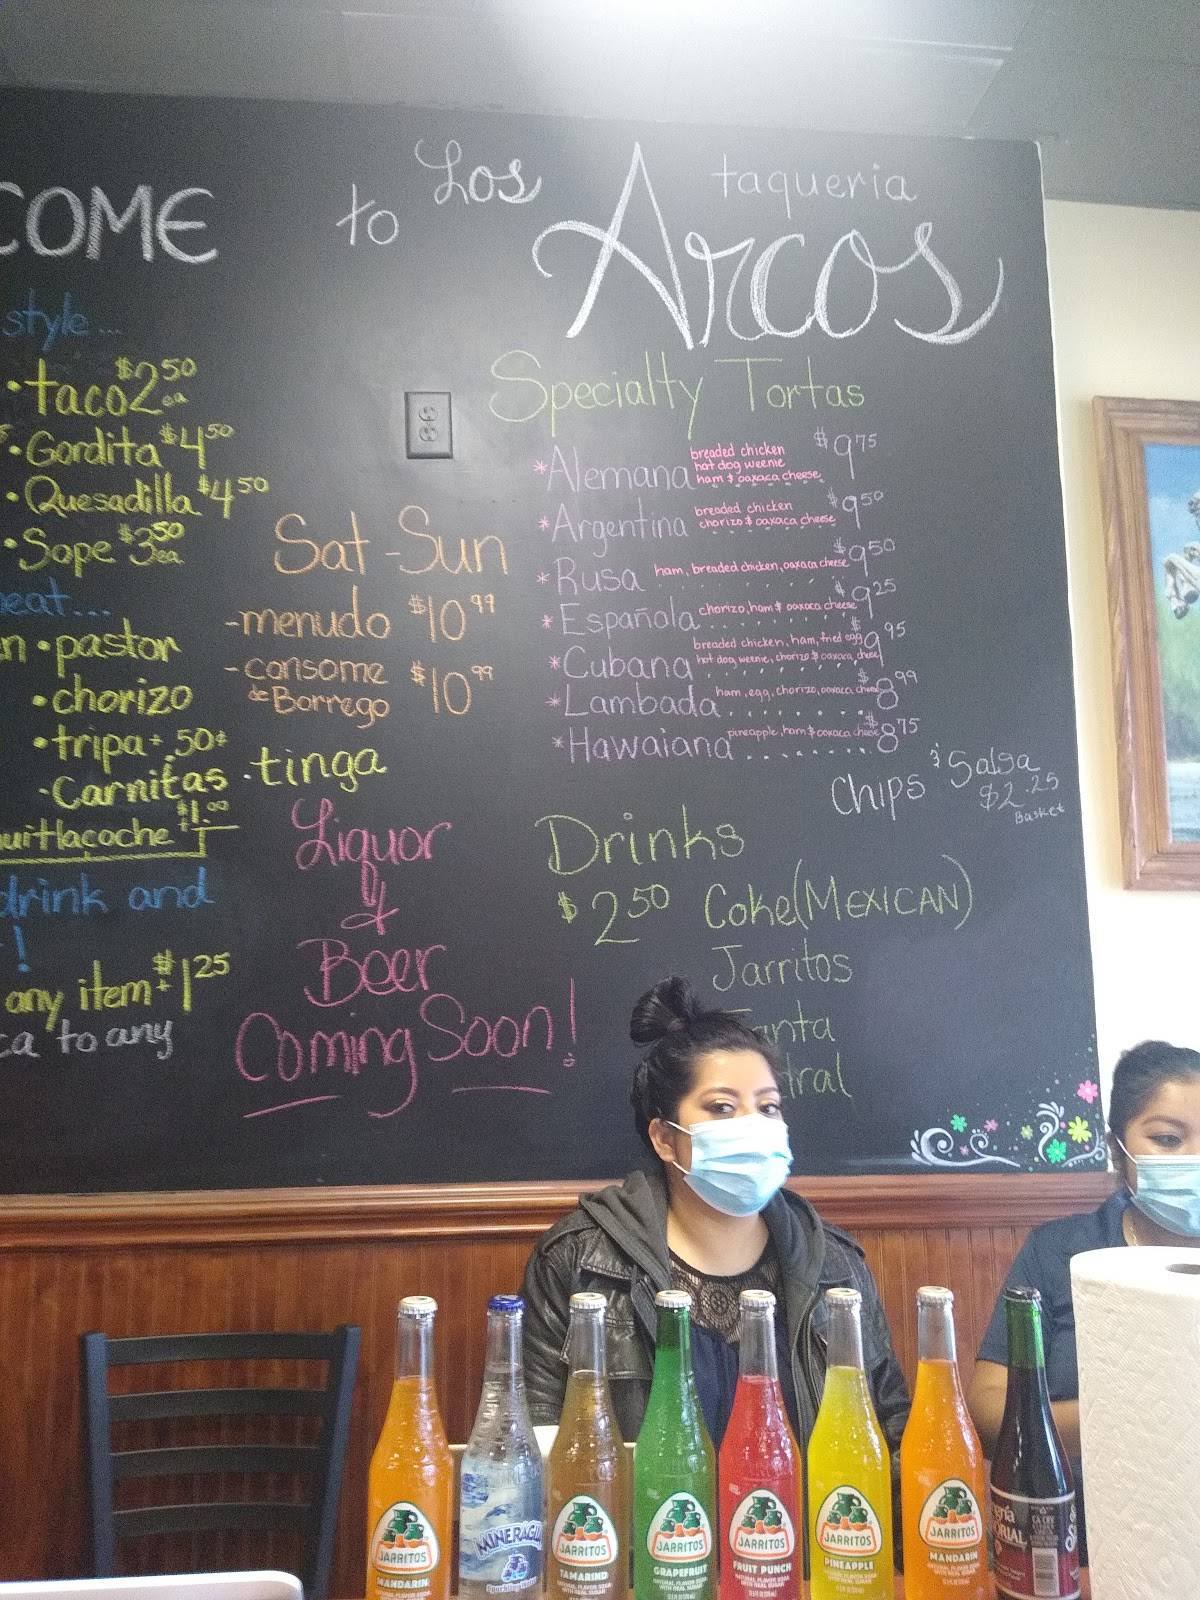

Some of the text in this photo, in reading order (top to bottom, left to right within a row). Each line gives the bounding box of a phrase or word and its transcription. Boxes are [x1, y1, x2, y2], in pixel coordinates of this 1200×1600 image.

[414, 140, 542, 205] Los
[711, 152, 917, 219] taqueria
[336, 184, 399, 246] to
[532, 141, 1004, 350] Arcos
[490, 349, 865, 441] Specialty Tortas
[26, 425, 163, 468] Gordita
[547, 444, 697, 492] Alemana
[691, 441, 785, 460] breaded chicken
[694, 458, 786, 475] hot dog weenie
[24, 471, 203, 518] Quesadilla
[696, 474, 723, 484] ham
[738, 473, 780, 483] oaxaca
[782, 469, 822, 481] cheese
[552, 496, 689, 558] Argentina
[694, 500, 793, 517] breaded chicken
[699, 515, 743, 529] chorizo
[755, 515, 798, 527] oaxaca
[800, 512, 836, 525] cheese
[19, 526, 116, 578] Sope
[274, 510, 370, 576] Sat
[554, 556, 646, 595] Rusa
[692, 560, 738, 575] breaded
[783, 559, 818, 570] oaxaca
[820, 556, 850, 568] cheese
[560, 595, 700, 639] Española
[786, 602, 822, 612] oaxaca
[824, 596, 858, 610] cheese
[56, 617, 182, 678] pastor
[693, 637, 737, 650] breaded
[819, 631, 842, 644] fried
[845, 632, 864, 646] egg
[696, 653, 713, 664] hot
[716, 654, 738, 669] dog
[775, 651, 810, 662] chorizo
[820, 651, 854, 661] oaxaca
[563, 645, 693, 680] Cubana
[52, 673, 193, 715] chorizo
[272, 685, 390, 729] Borrego
[565, 681, 721, 717] Lambada
[51, 724, 148, 774] tripa
[569, 726, 734, 764] Hawaiana
[816, 727, 851, 738] oaxaca
[53, 754, 228, 810] Carnitas
[250, 746, 388, 793] tinga
[831, 773, 926, 821] Chips
[1014, 802, 1065, 825] Basket
[292, 797, 452, 907] Liquor
[534, 804, 745, 875] Drinks
[128, 865, 216, 911] and
[296, 938, 447, 1007] Beer
[711, 937, 854, 992] Jarritos
[5, 988, 64, 1032] any
[78, 960, 152, 1011] item
[56, 1018, 98, 1053] to
[105, 1019, 174, 1061] any
[236, 1011, 418, 1119] Coming
[560, 1543, 607, 1557] JARRITOS
[656, 1539, 704, 1552] JARRITOS
[738, 1536, 785, 1549] JARRITOS
[825, 1532, 872, 1546] JARRITOS
[930, 1525, 975, 1538] JARRITOS
[378, 1551, 427, 1564] JARRITOS
[559, 1569, 609, 1582] TAMARIND
[653, 1564, 708, 1577] GRAPEFRUIT
[733, 1560, 791, 1575] FRUIT PUNCH
[824, 1557, 874, 1570] PINEAPPLE
[929, 1551, 978, 1562] MANDARIN
